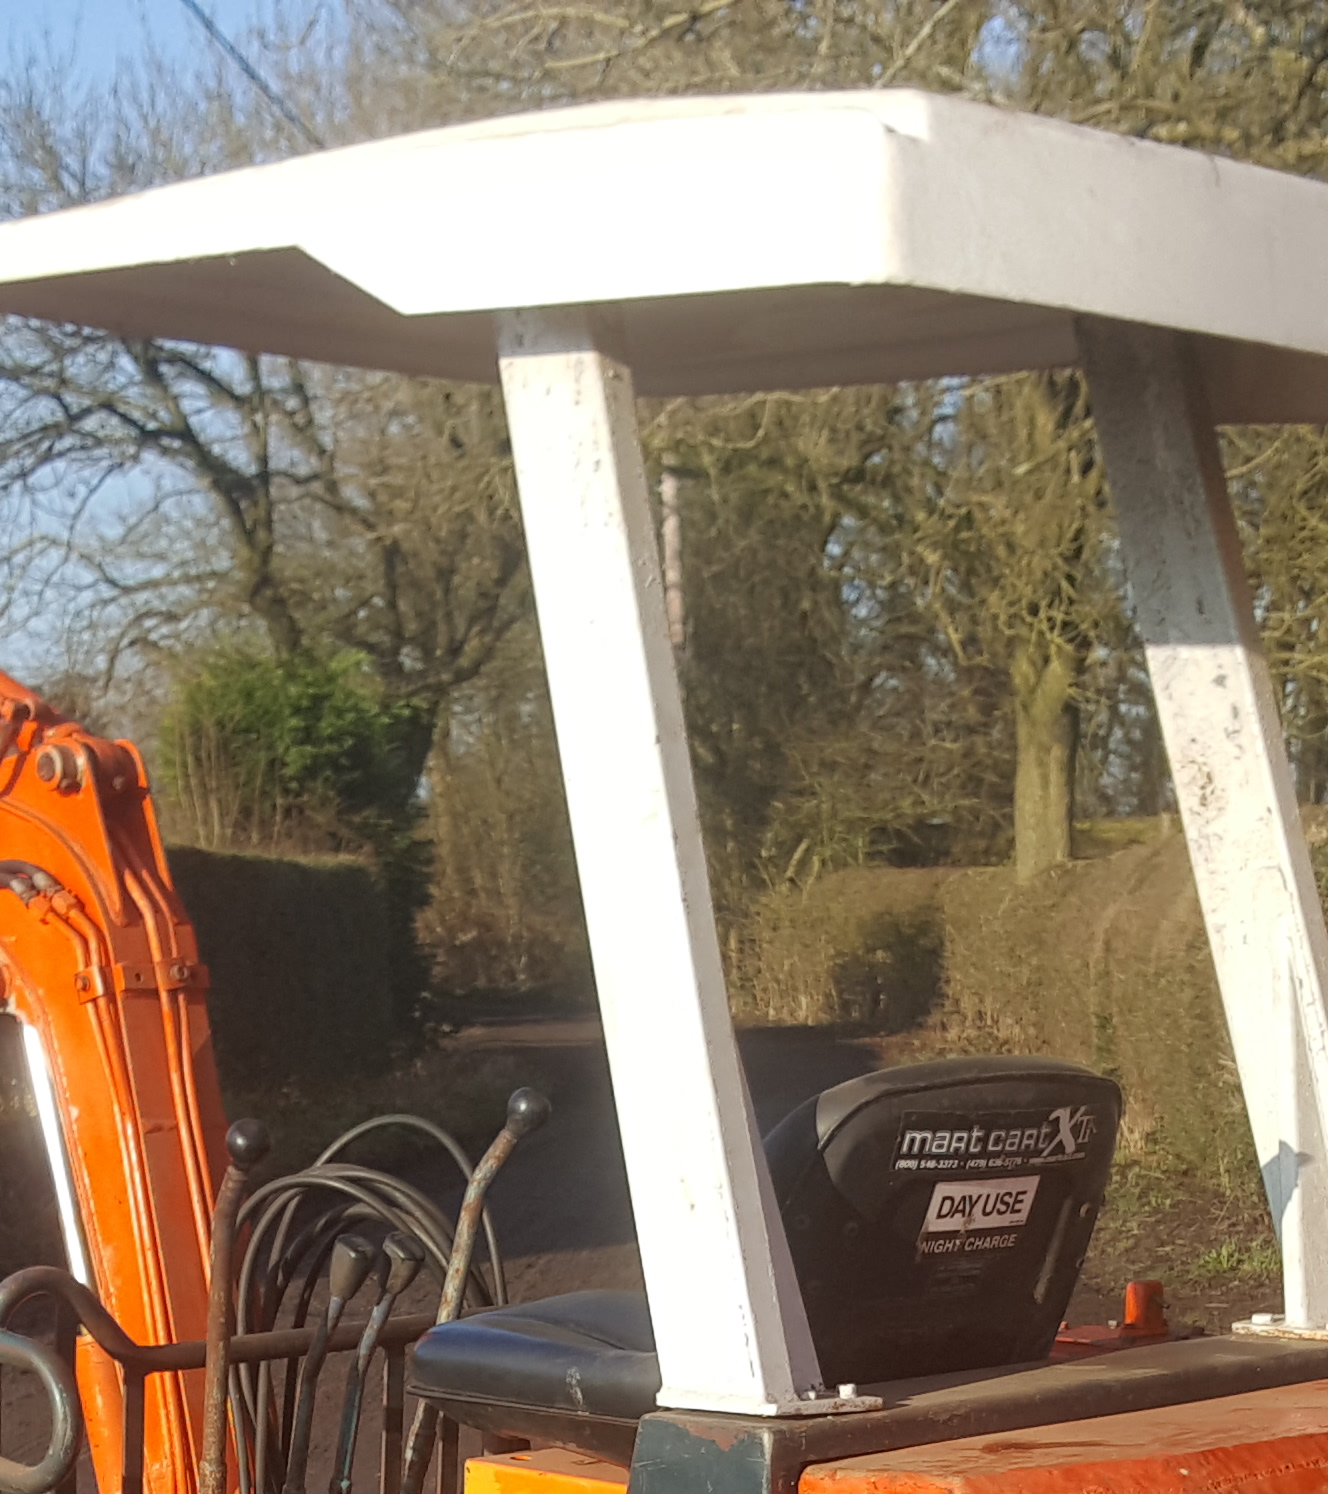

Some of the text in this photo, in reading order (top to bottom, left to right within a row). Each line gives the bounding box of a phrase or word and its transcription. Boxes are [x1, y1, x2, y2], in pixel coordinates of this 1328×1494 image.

[936, 1190, 1027, 1219] DAY USE
[920, 1234, 1017, 1253] NIGHT CHARGE
